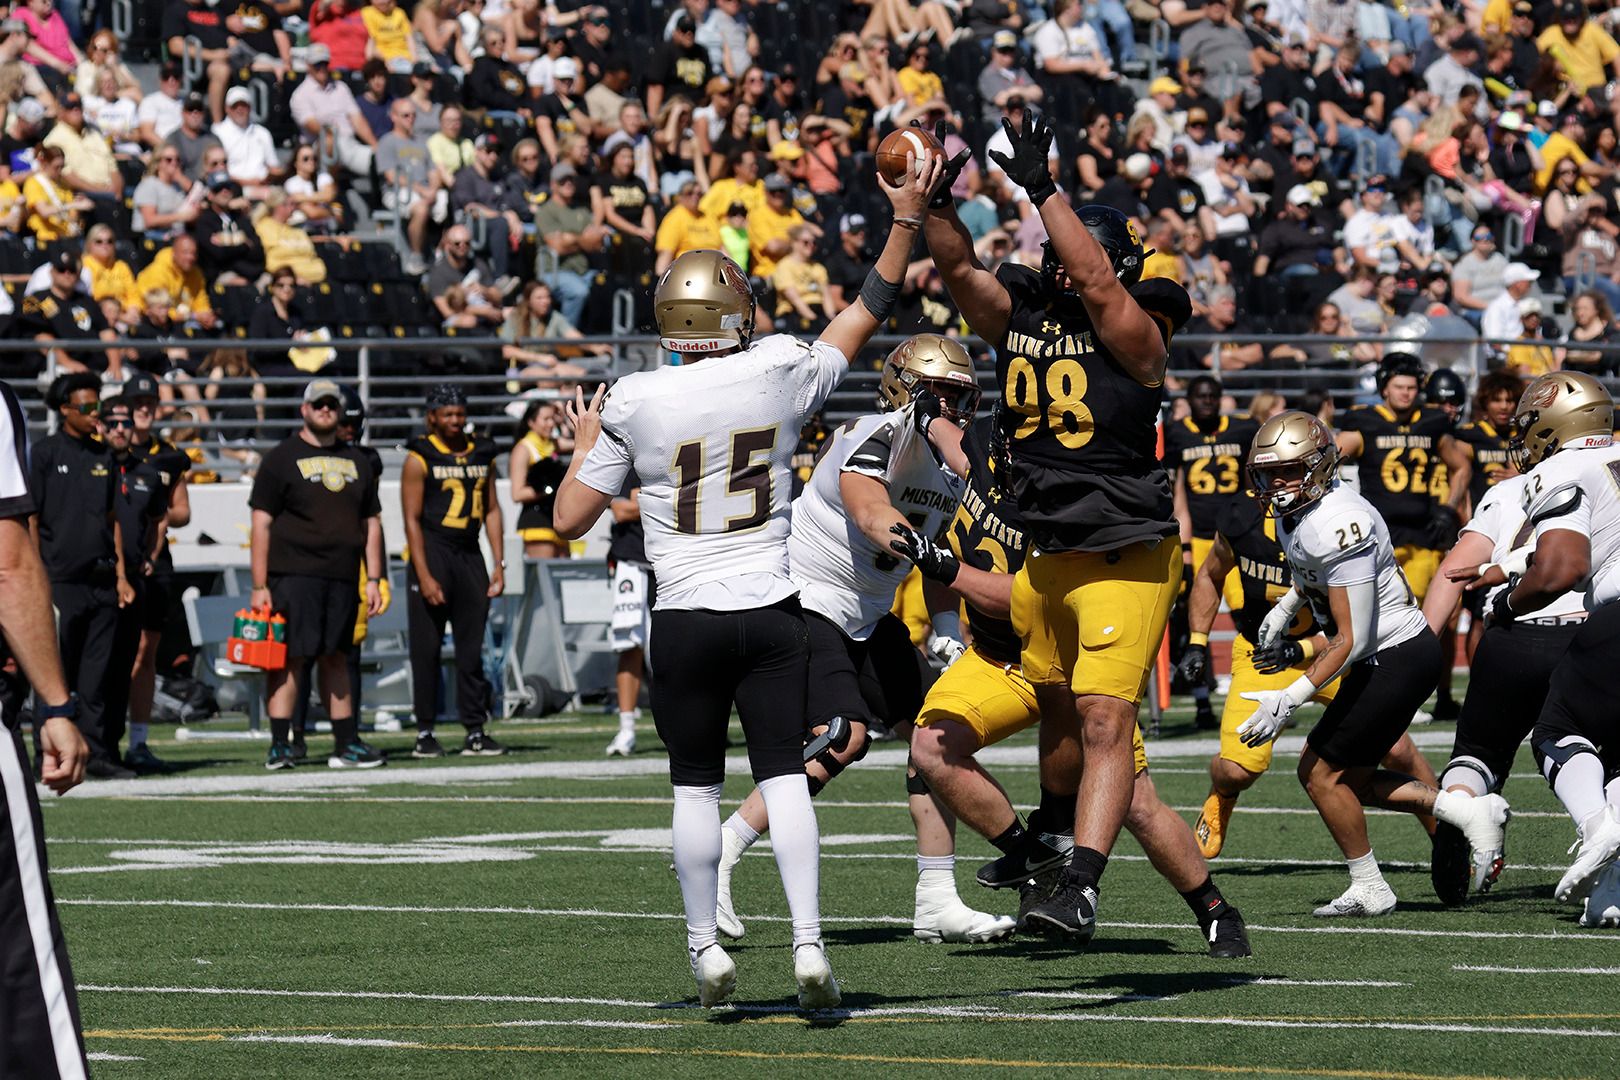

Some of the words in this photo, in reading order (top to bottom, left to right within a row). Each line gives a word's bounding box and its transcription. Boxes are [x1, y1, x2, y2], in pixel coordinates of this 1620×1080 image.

[669, 340, 719, 352] Riddell
[1044, 330, 1095, 357] STATE
[1005, 356, 1095, 450] 98
[1585, 436, 1612, 448] Ridd
[465, 464, 490, 479] STAT
[668, 421, 783, 538] 15
[1187, 454, 1240, 495] 63
[1380, 447, 1428, 494] 62
[900, 486, 958, 515] MUSTANGS
[1524, 473, 1544, 505] 52
[982, 512, 1024, 551] STATE
[1335, 522, 1363, 551] 29
[1240, 556, 1284, 585] WAYNE
